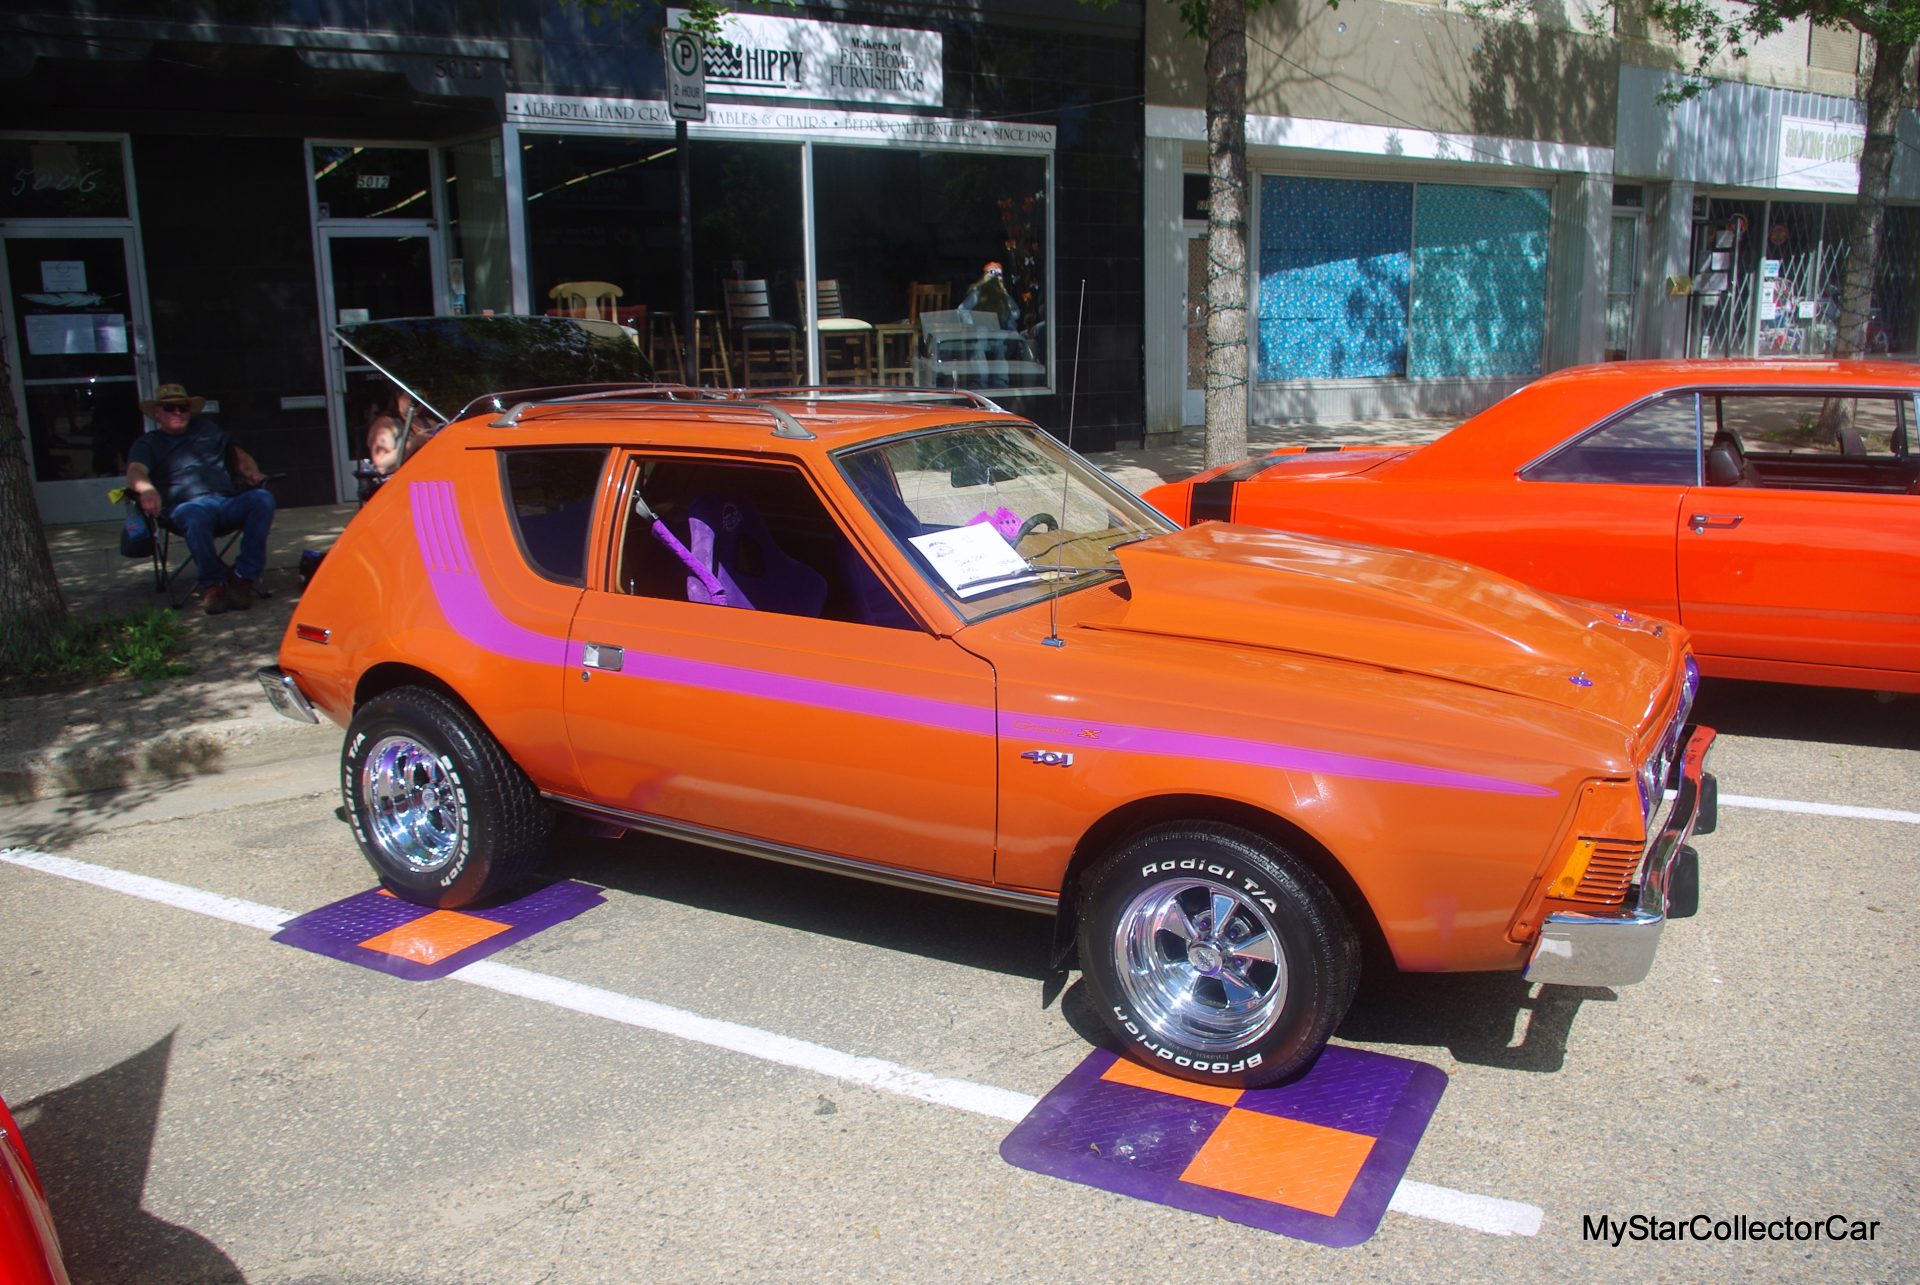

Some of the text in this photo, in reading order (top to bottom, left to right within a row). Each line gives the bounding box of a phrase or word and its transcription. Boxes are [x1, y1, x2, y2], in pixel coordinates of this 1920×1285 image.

[680, 44, 692, 66] P
[851, 38, 902, 52] Makers of
[746, 48, 803, 83] HIPPY
[840, 48, 915, 70] FINE HOME
[830, 65, 925, 92] FURNISHINGS
[673, 84, 700, 99] 2 HOUR
[524, 102, 590, 118] ALBERTA
[594, 105, 635, 120] HAND
[708, 111, 758, 126] TABLES
[762, 114, 772, 126] &
[775, 114, 828, 129] CHAIRS
[844, 118, 913, 136] BEDROOM
[913, 122, 977, 139] FURNITURE
[992, 127, 1025, 142] SINCE
[1026, 130, 1052, 144] 1990
[11, 168, 103, 197] 5006
[357, 175, 390, 189] 5012
[348, 732, 366, 760] T/A
[1020, 749, 1075, 768] 401
[1141, 857, 1279, 915] Radial T/A
